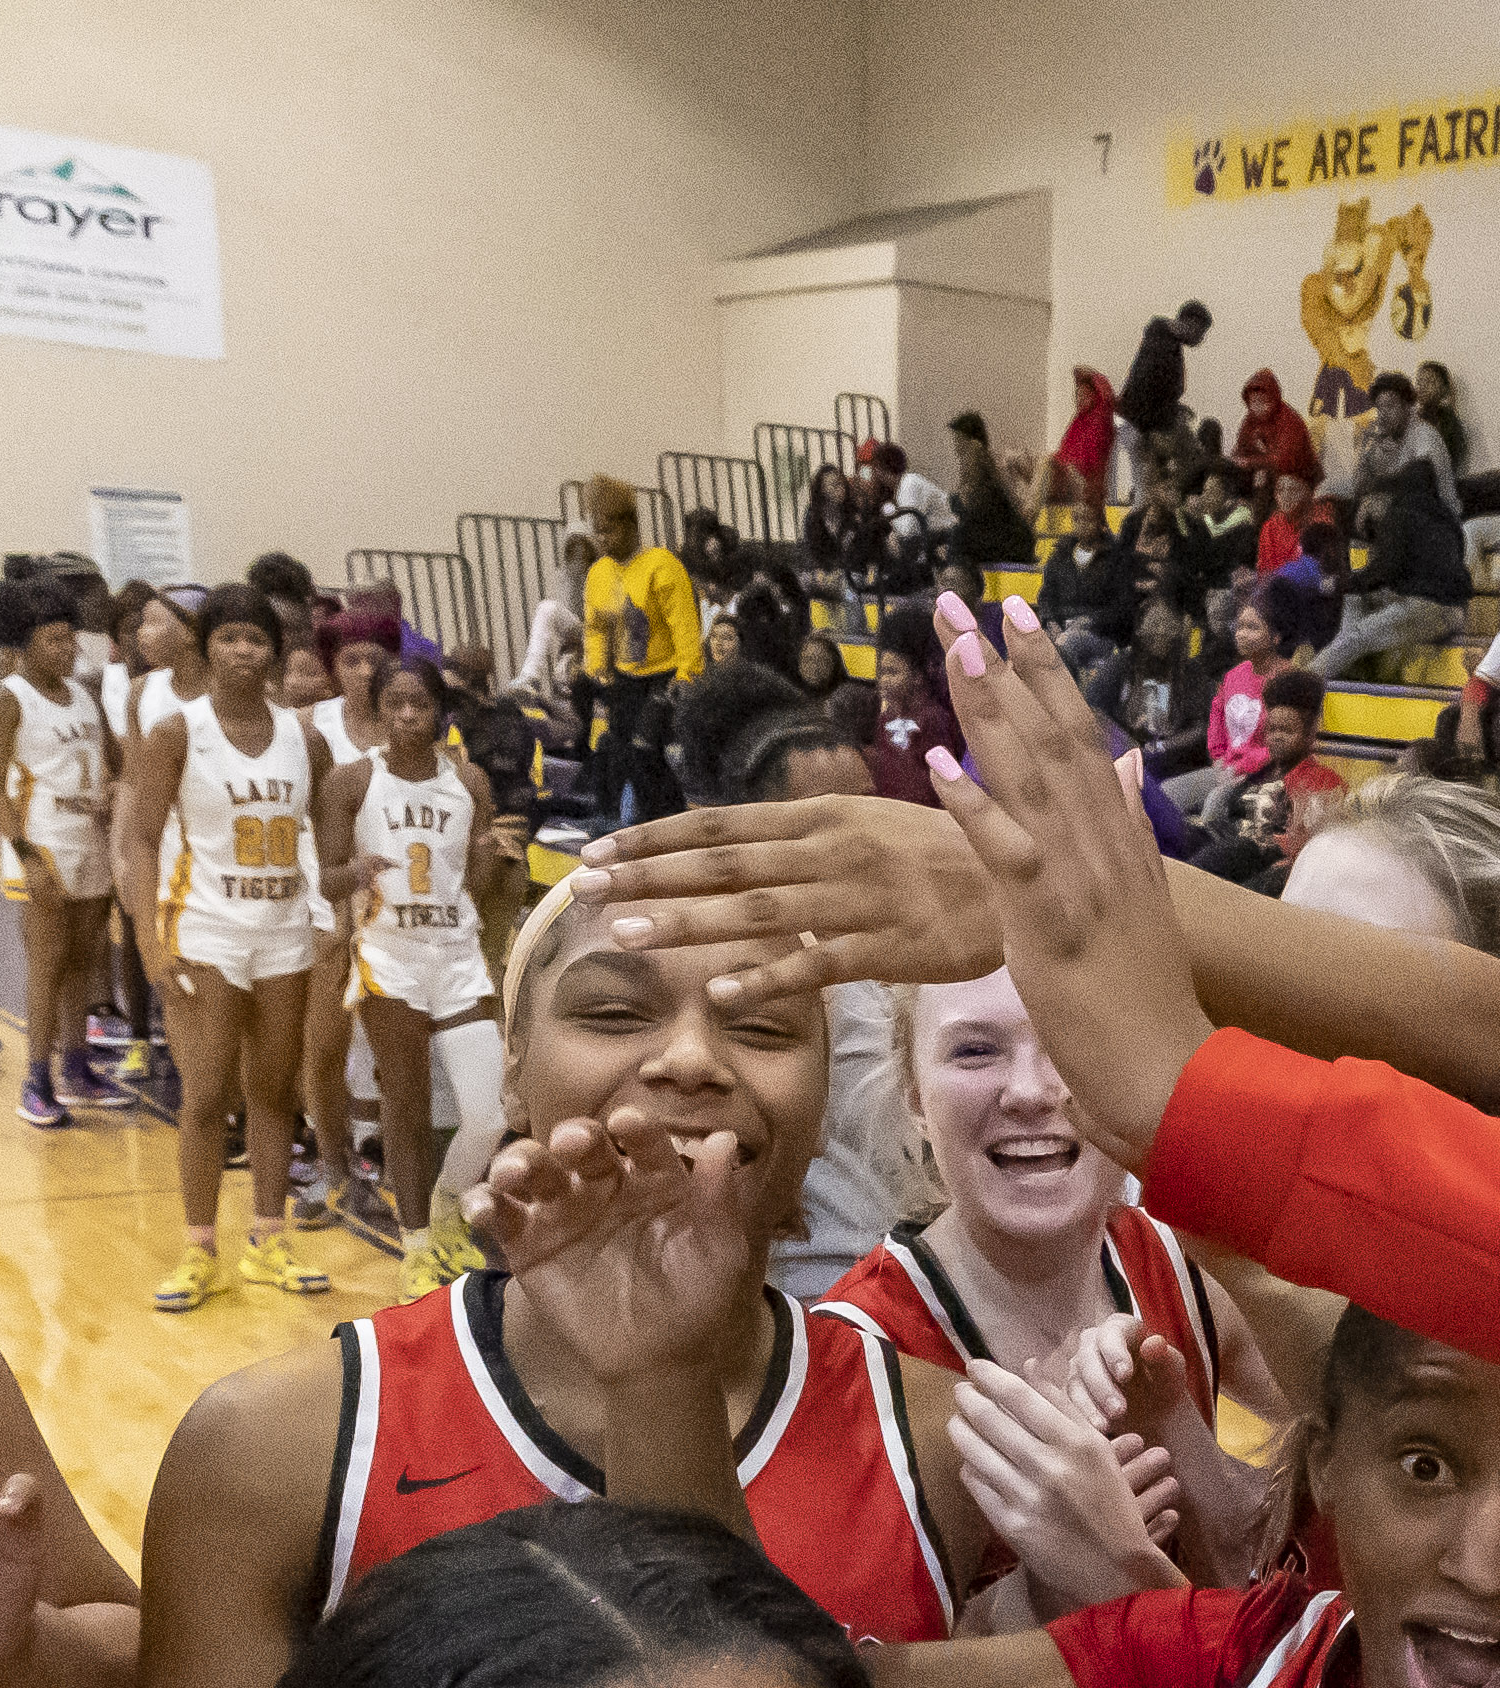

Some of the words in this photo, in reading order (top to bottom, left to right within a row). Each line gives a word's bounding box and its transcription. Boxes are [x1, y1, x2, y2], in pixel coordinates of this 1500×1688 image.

[1241, 139, 1291, 190] WE
[1308, 124, 1380, 184] ARE
[225, 777, 295, 806] LADY
[382, 803, 453, 834] LADY
[406, 841, 431, 895] 2
